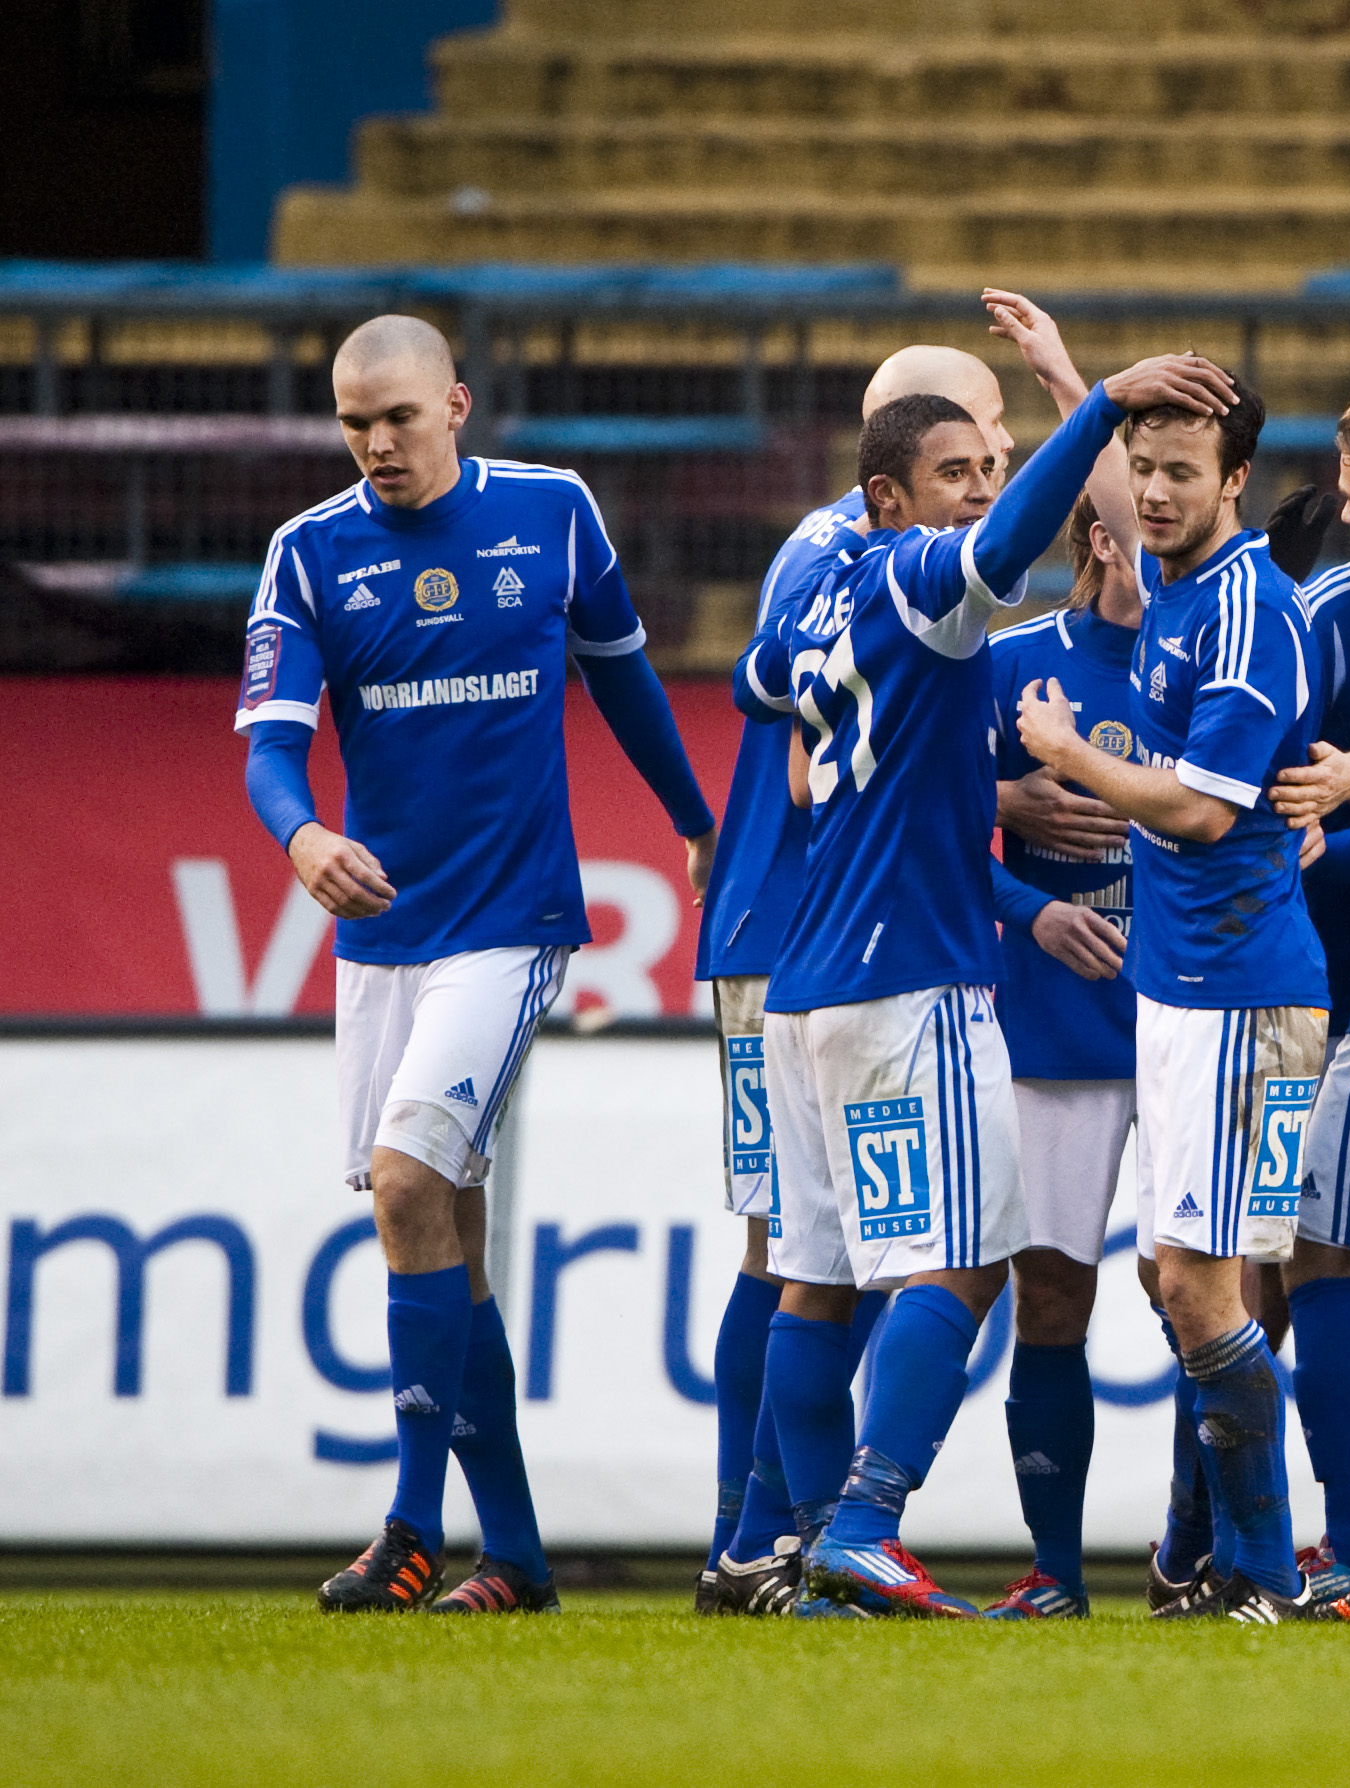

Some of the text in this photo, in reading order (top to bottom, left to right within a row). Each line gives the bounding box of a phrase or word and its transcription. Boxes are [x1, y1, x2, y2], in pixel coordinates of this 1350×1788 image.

[497, 597, 523, 608] SCA
[416, 613, 464, 627] SUNDSVALL
[358, 668, 540, 711] NORRLANDSLAGET
[850, 1102, 917, 1120] MEDIE
[736, 1157, 770, 1170] HUS
[857, 1128, 920, 1210] ST
[1252, 1200, 1300, 1212] HUSE
[864, 1217, 926, 1237] HUSET
